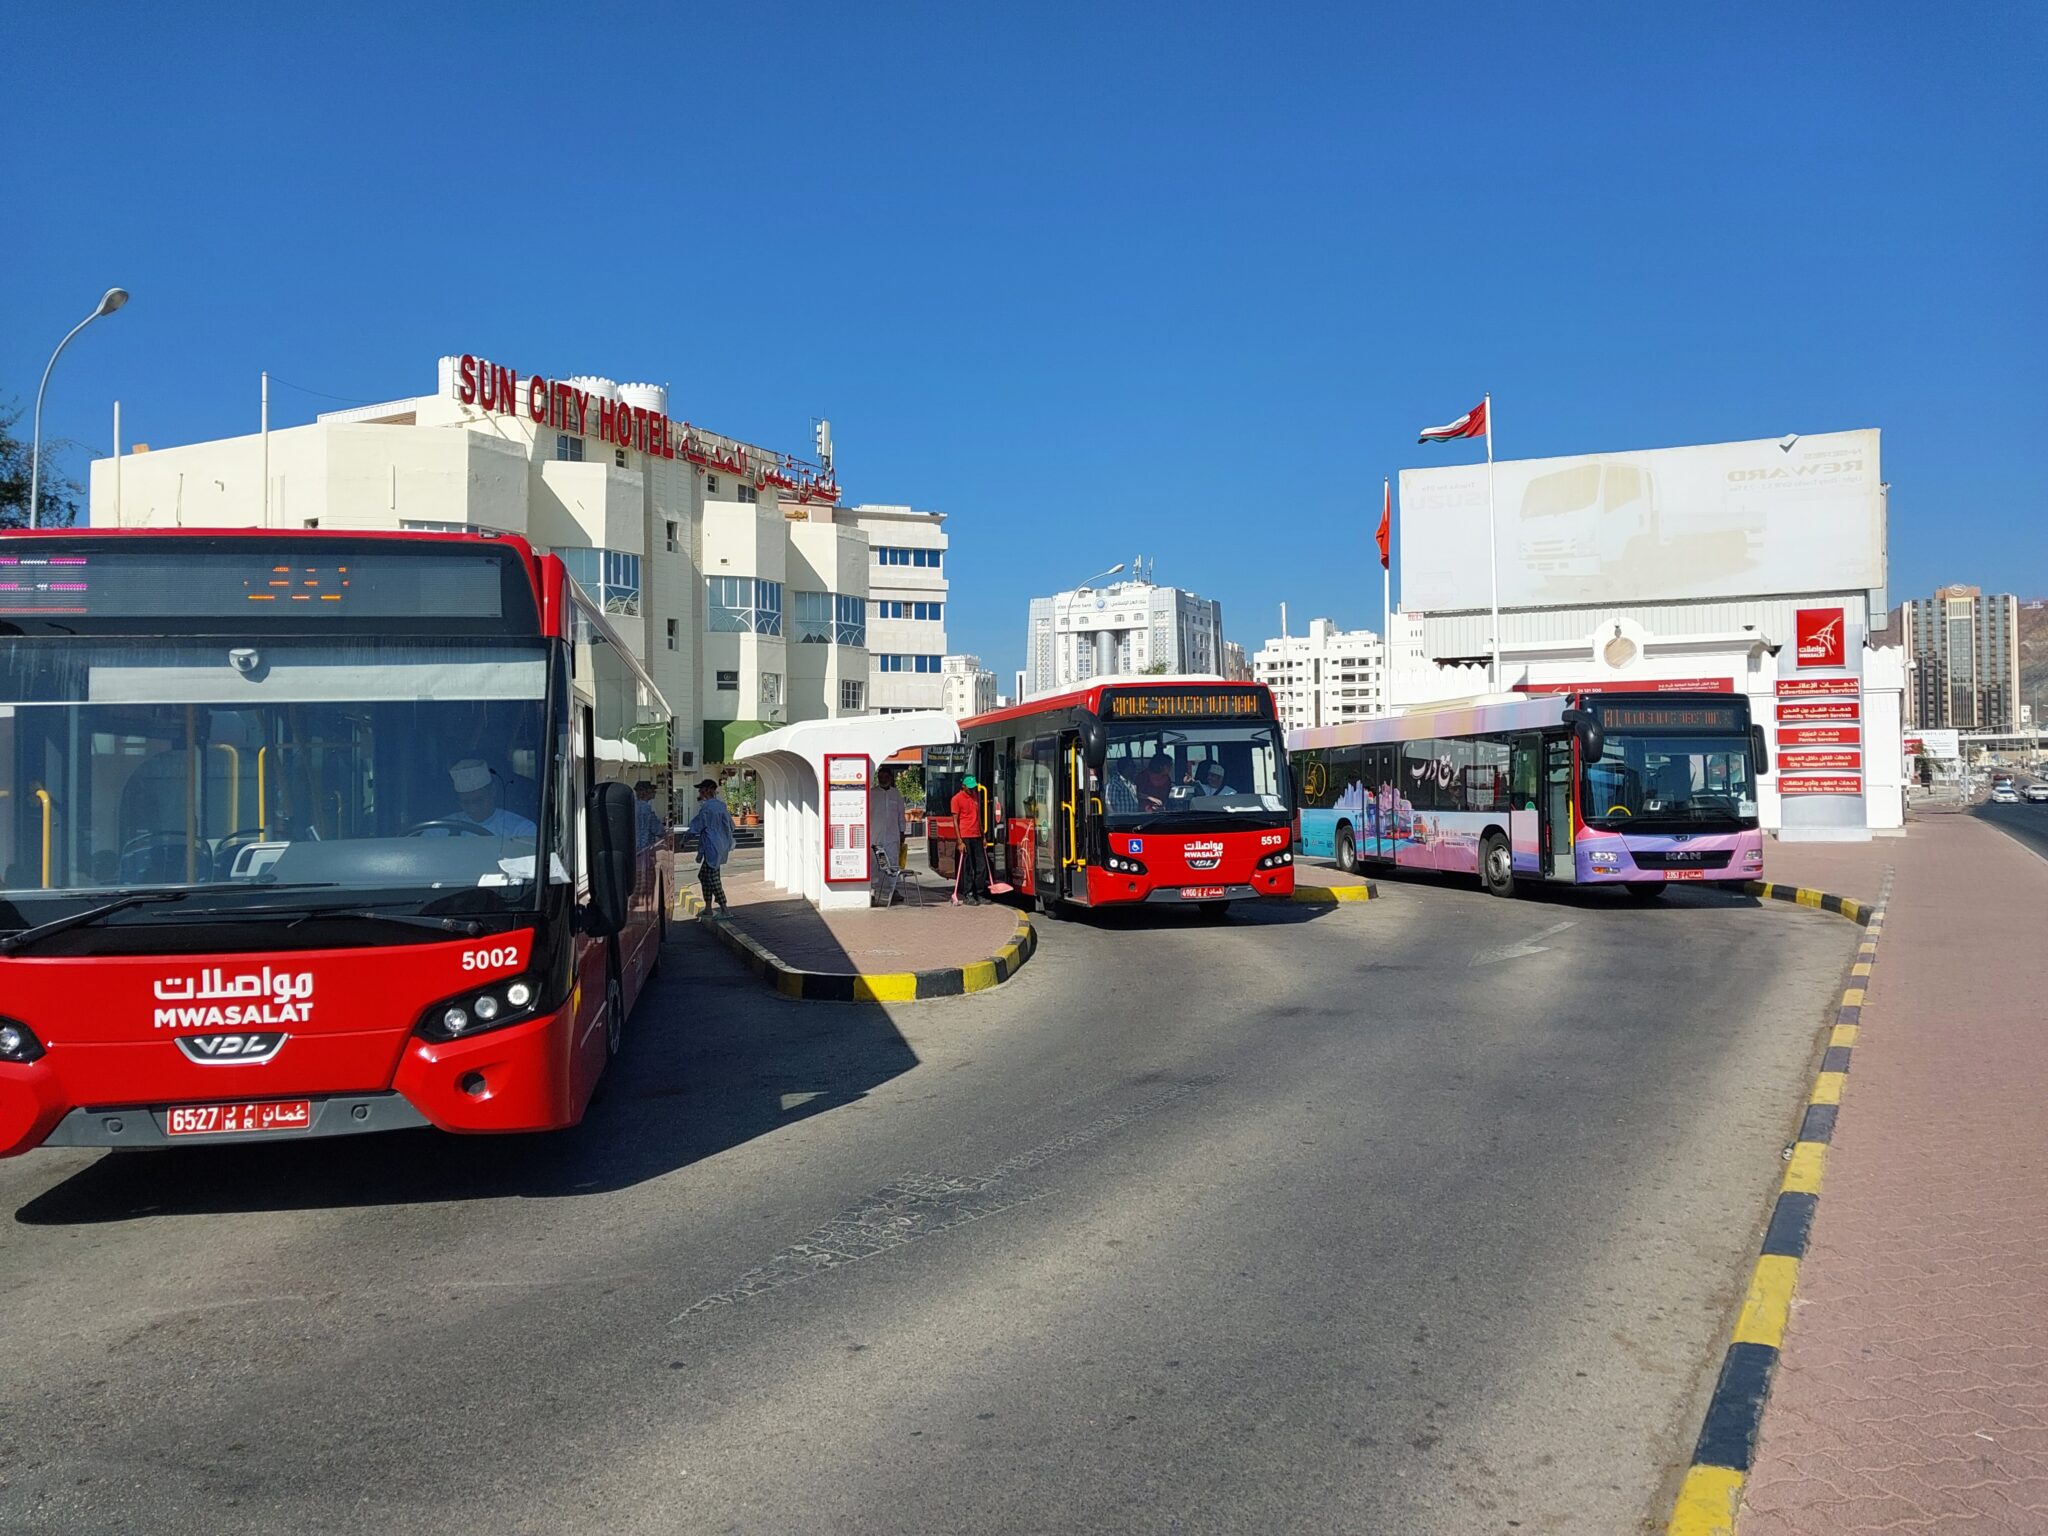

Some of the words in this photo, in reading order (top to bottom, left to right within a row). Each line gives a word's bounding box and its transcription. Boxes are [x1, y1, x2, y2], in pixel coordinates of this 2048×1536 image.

[460, 353, 517, 417] SUN
[529, 374, 590, 437] CITY
[600, 396, 675, 460] HOTEL
[1183, 840, 1224, 852] مواصلات
[1260, 835, 1282, 846] 5513
[1183, 850, 1224, 859] MWASALAT
[461, 947, 518, 971] 5002
[153, 965, 314, 1004] مواصلات
[153, 1002, 315, 1029] MWASALAT
[192, 1035, 269, 1056] VDL
[172, 1106, 219, 1132] 6527
